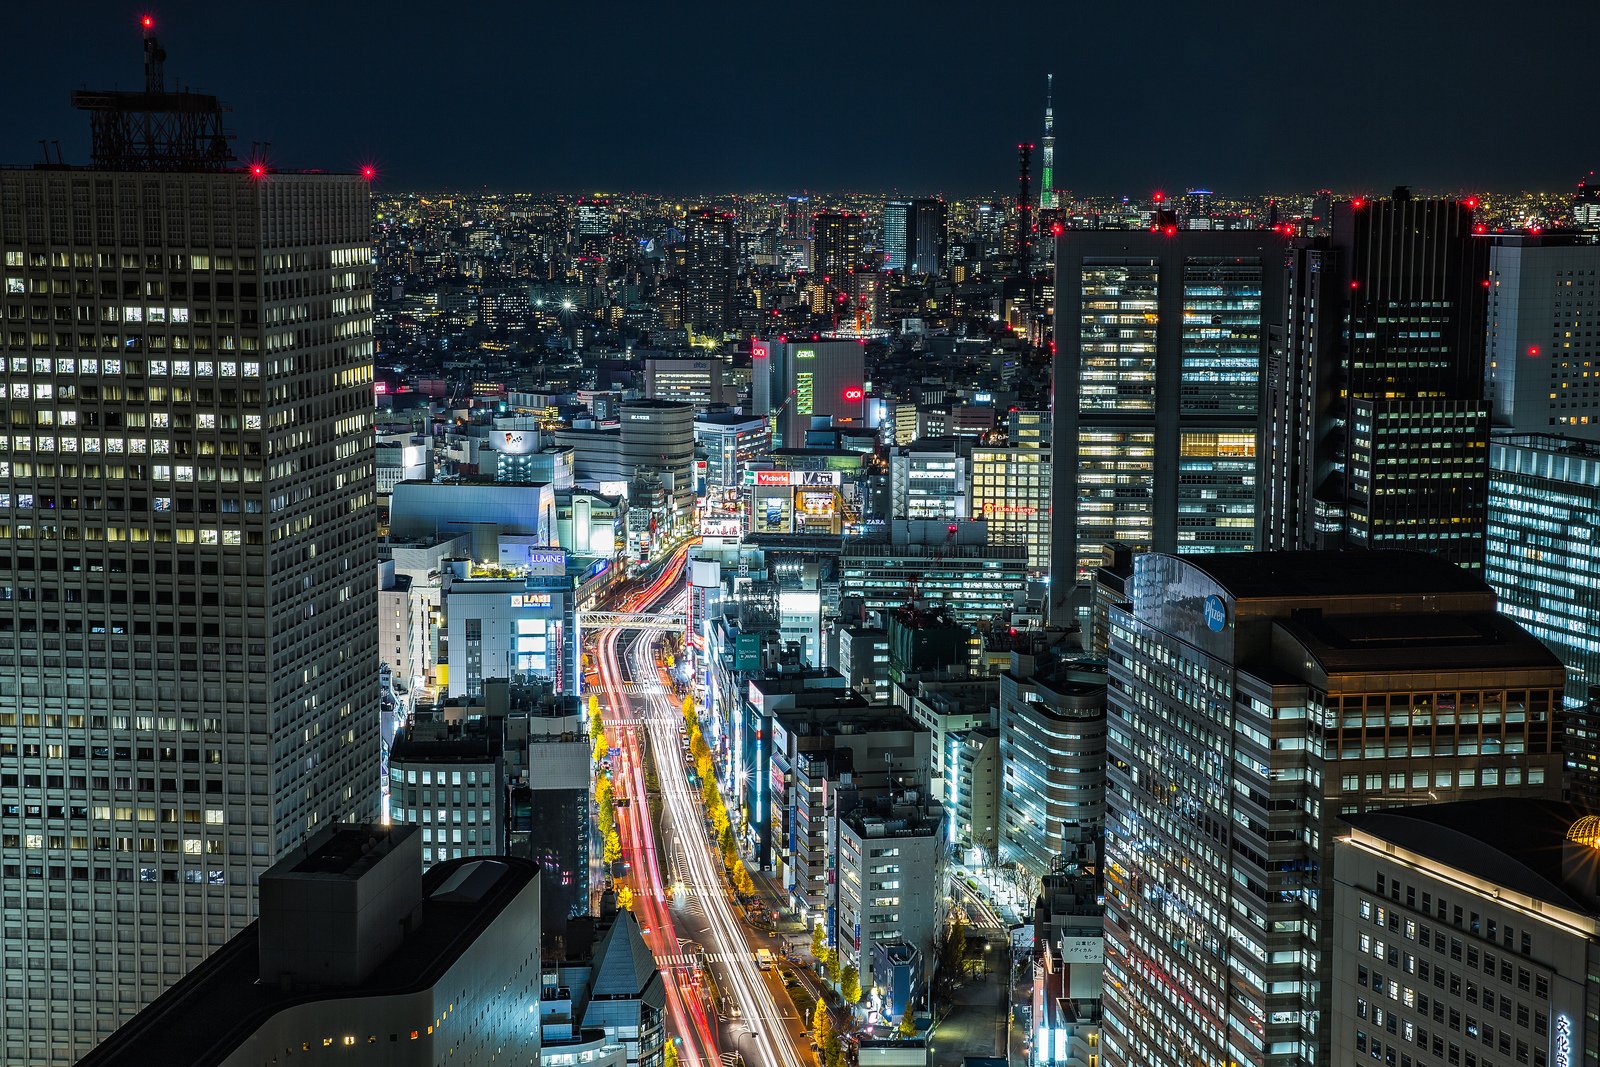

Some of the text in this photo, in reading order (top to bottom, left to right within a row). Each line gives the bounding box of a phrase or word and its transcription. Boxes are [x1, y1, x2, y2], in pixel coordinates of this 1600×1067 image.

[760, 474, 788, 482] Victoria
[994, 504, 1036, 515] Takashimaya
[532, 554, 561, 563] LUMINE
[1204, 599, 1226, 629] Pfizer
